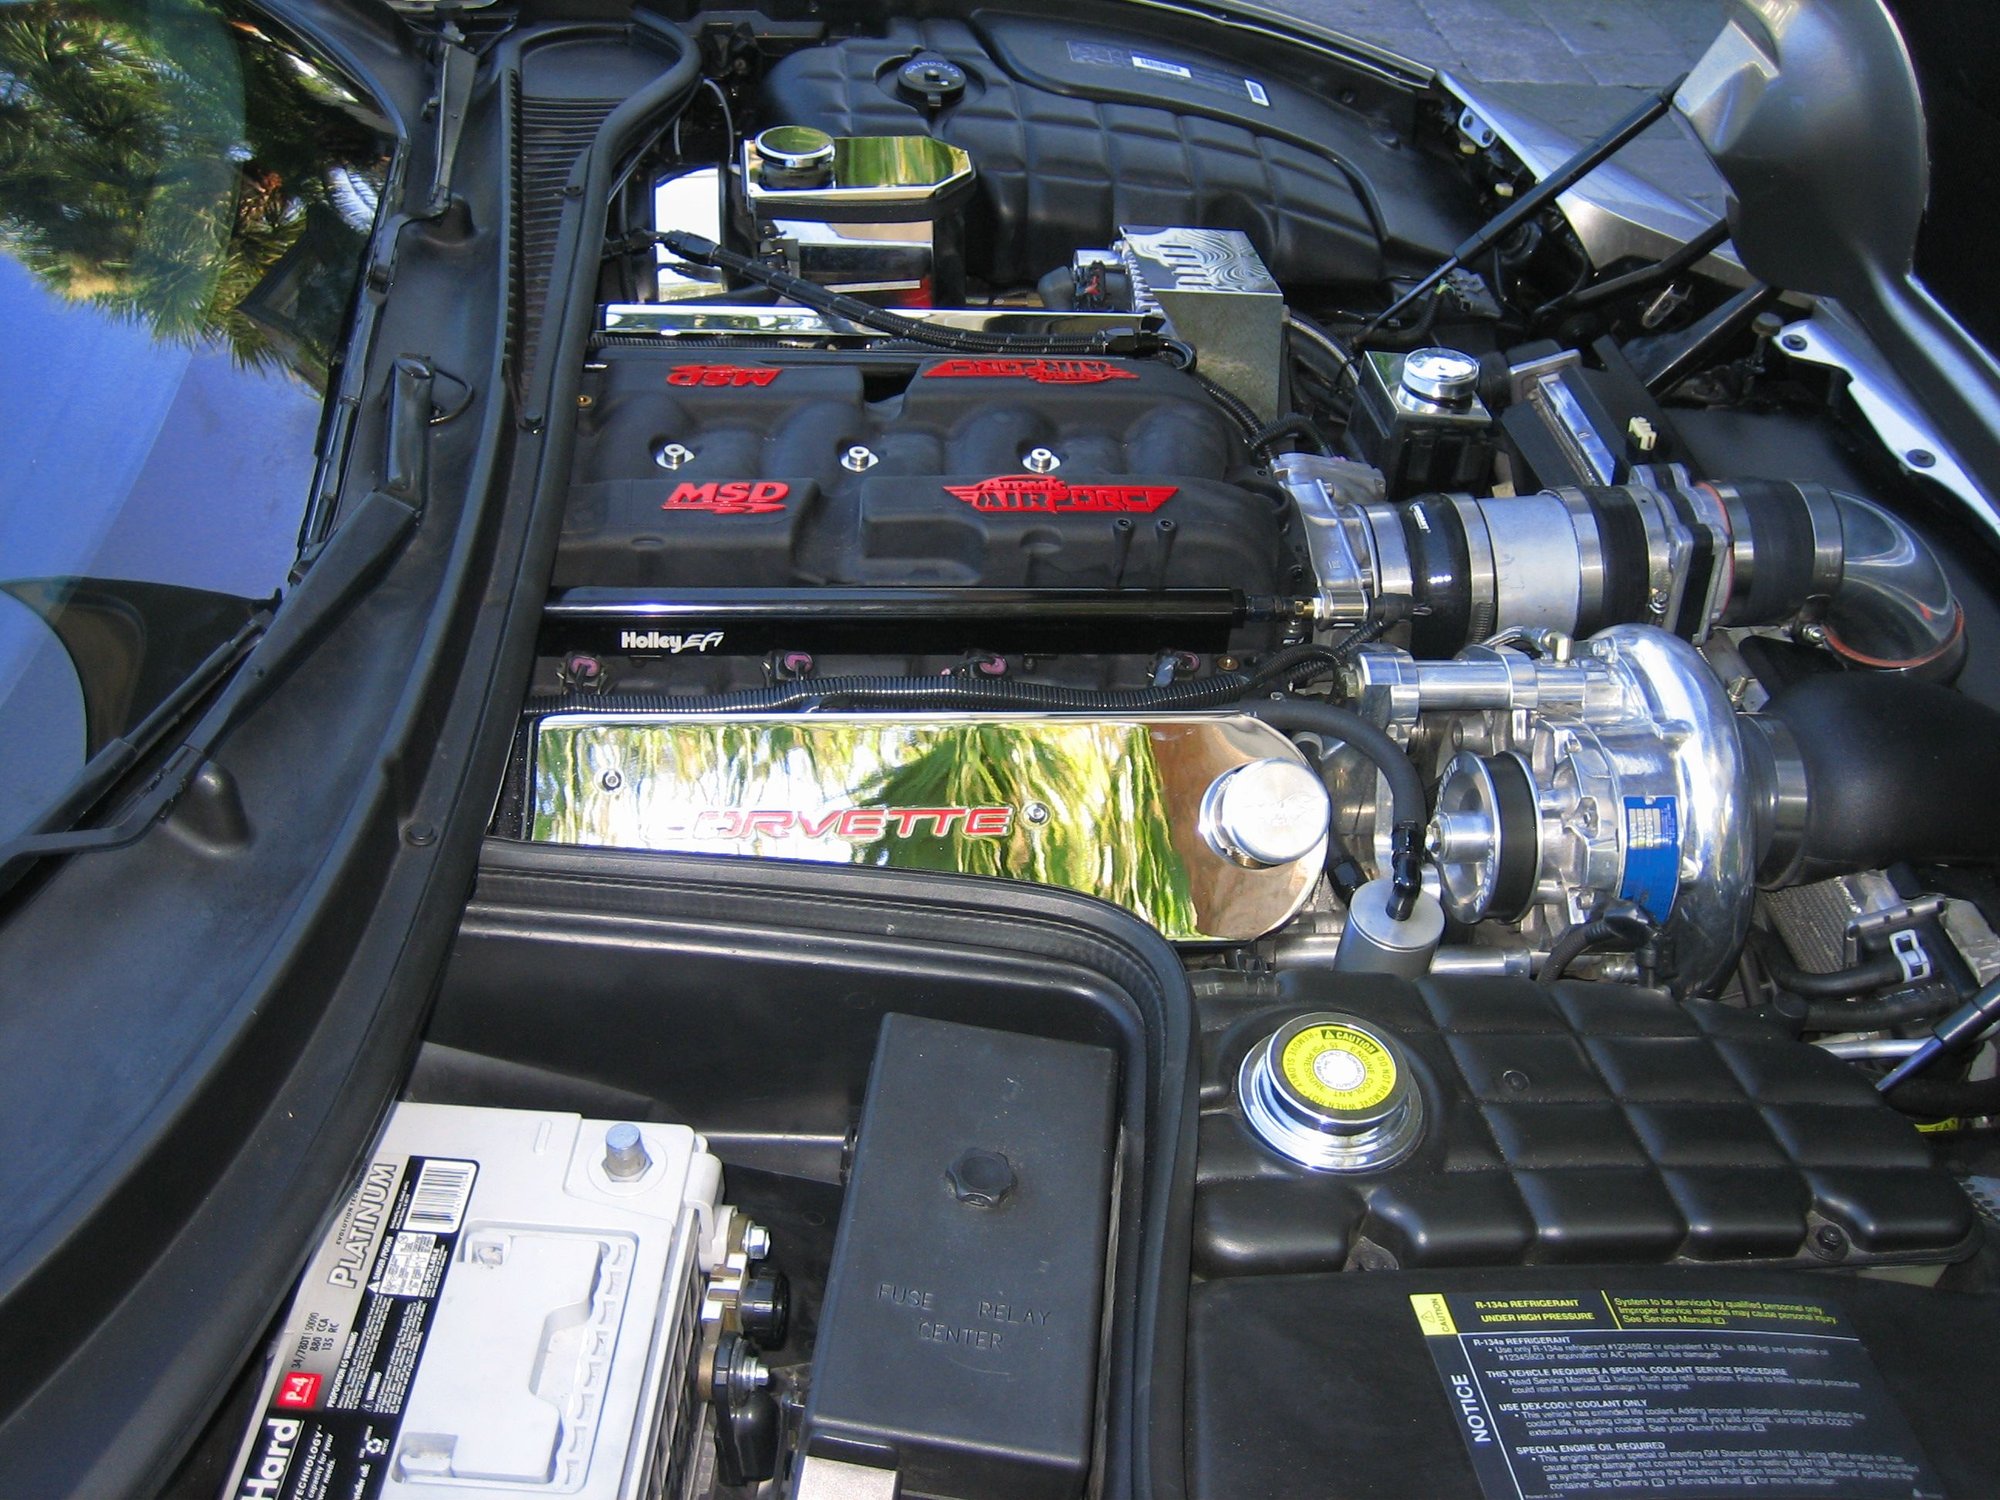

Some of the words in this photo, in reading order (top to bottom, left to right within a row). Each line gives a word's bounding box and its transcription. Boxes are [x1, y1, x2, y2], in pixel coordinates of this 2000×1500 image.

[666, 365, 783, 387] MSD
[665, 482, 790, 509] MSD
[621, 631, 681, 653] Holley
[682, 632, 724, 651] EFI
[1336, 1031, 1377, 1053] CAUTION
[327, 1162, 397, 1289] PLATINUM
[878, 1282, 934, 1310] FUSE
[978, 1301, 1051, 1326] RELAY
[1474, 1300, 1509, 1309] R-134a
[1510, 1299, 1580, 1308] REFRIGERANT
[1614, 1297, 1648, 1307] System
[1649, 1298, 1659, 1306] to
[1712, 1300, 1724, 1309] by
[1432, 1298, 1450, 1332] CAUTION
[1480, 1314, 1516, 1323] UNDER
[1516, 1313, 1540, 1322] HIGH
[1540, 1312, 1595, 1321] PRESSURE
[1622, 1315, 1642, 1323] See
[1644, 1315, 1678, 1323] Service
[317, 1318, 330, 1332] CCA
[322, 1338, 334, 1351] 135
[328, 1323, 339, 1333] RC
[918, 1321, 1003, 1350] CENTER
[1472, 1338, 1504, 1346] R-134a
[1504, 1336, 1570, 1345] REFRIGERANT
[1494, 1346, 1511, 1354] Use
[1512, 1346, 1532, 1356] only
[1486, 1370, 1509, 1378] THIS
[1510, 1369, 1551, 1377] VEHICLE
[1551, 1368, 1600, 1376] REQUIRES
[1602, 1367, 1609, 1375] A
[1609, 1367, 1649, 1375] SPECIAL
[1650, 1366, 1694, 1374] COOLANT
[1695, 1366, 1734, 1374] SERVICE
[1734, 1367, 1788, 1376] PROCEDURE
[285, 1377, 309, 1401] P-4
[1511, 1386, 1536, 1394] could
[1451, 1373, 1492, 1444] NOTICE
[1499, 1403, 1520, 1411] USE
[1575, 1401, 1621, 1409] COOLANT
[1622, 1399, 1648, 1407] ONLY
[1521, 1411, 1542, 1419] This
[1583, 1427, 1613, 1436] engine
[1648, 1425, 1666, 1433] See
[317, 1453, 328, 1465] for
[323, 1433, 334, 1452] your
[1516, 1446, 1559, 1455] SPECIAL
[1560, 1444, 1597, 1453] ENGINE
[1598, 1443, 1615, 1451] OIL
[1616, 1441, 1666, 1450] REQUIRED
[1539, 1454, 1558, 1463] This
[1559, 1454, 1589, 1463] engine
[1542, 1463, 1570, 1472] cause
[1570, 1462, 1600, 1471] engine
[1593, 1480, 1612, 1489] See
